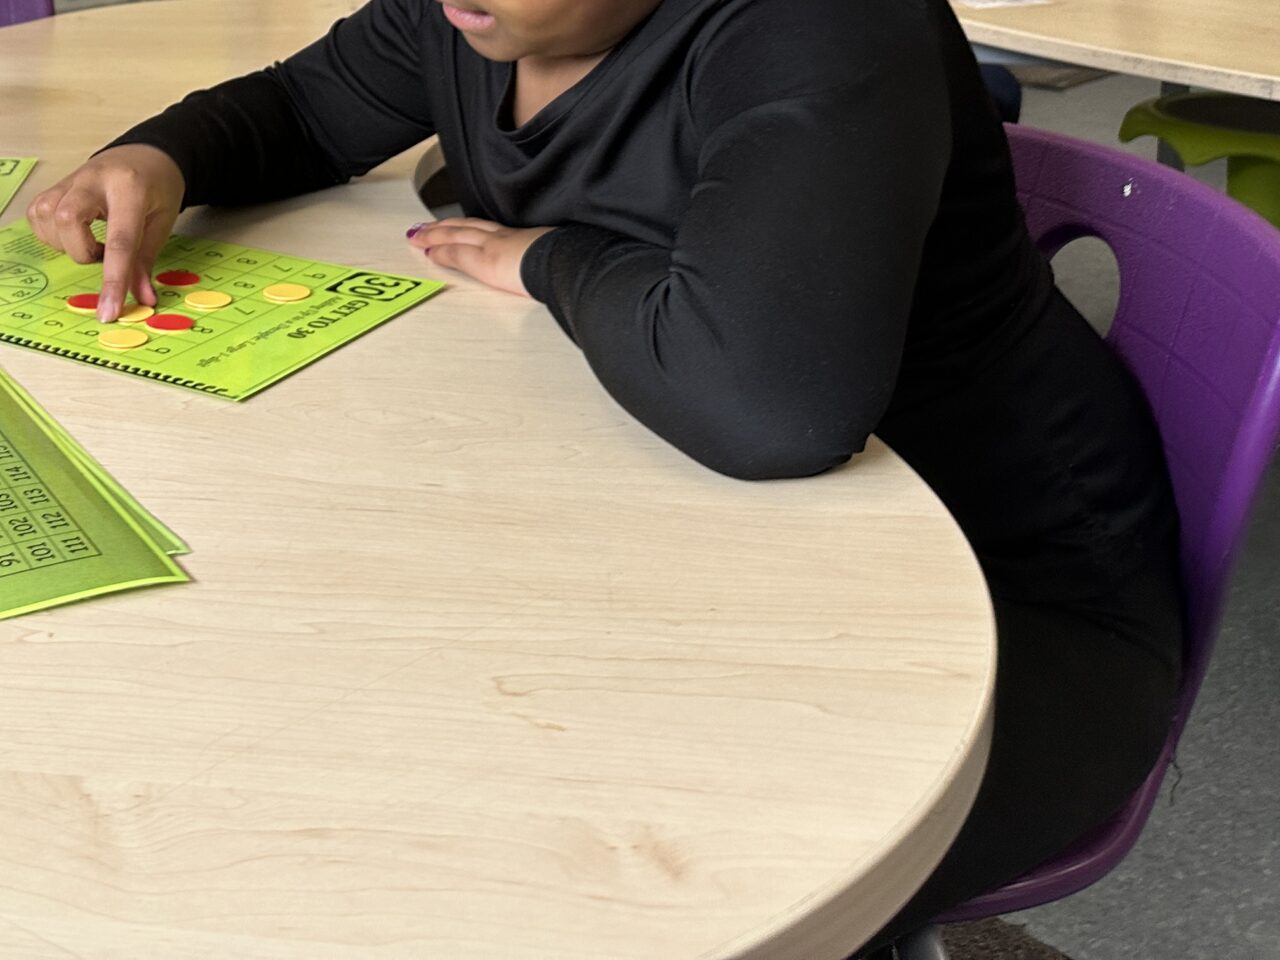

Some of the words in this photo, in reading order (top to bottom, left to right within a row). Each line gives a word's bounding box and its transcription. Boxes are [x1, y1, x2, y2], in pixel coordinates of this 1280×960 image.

[349, 276, 401, 297] 30
[339, 299, 369, 317] GET
[313, 312, 337, 329] TO
[287, 326, 315, 340] 30
